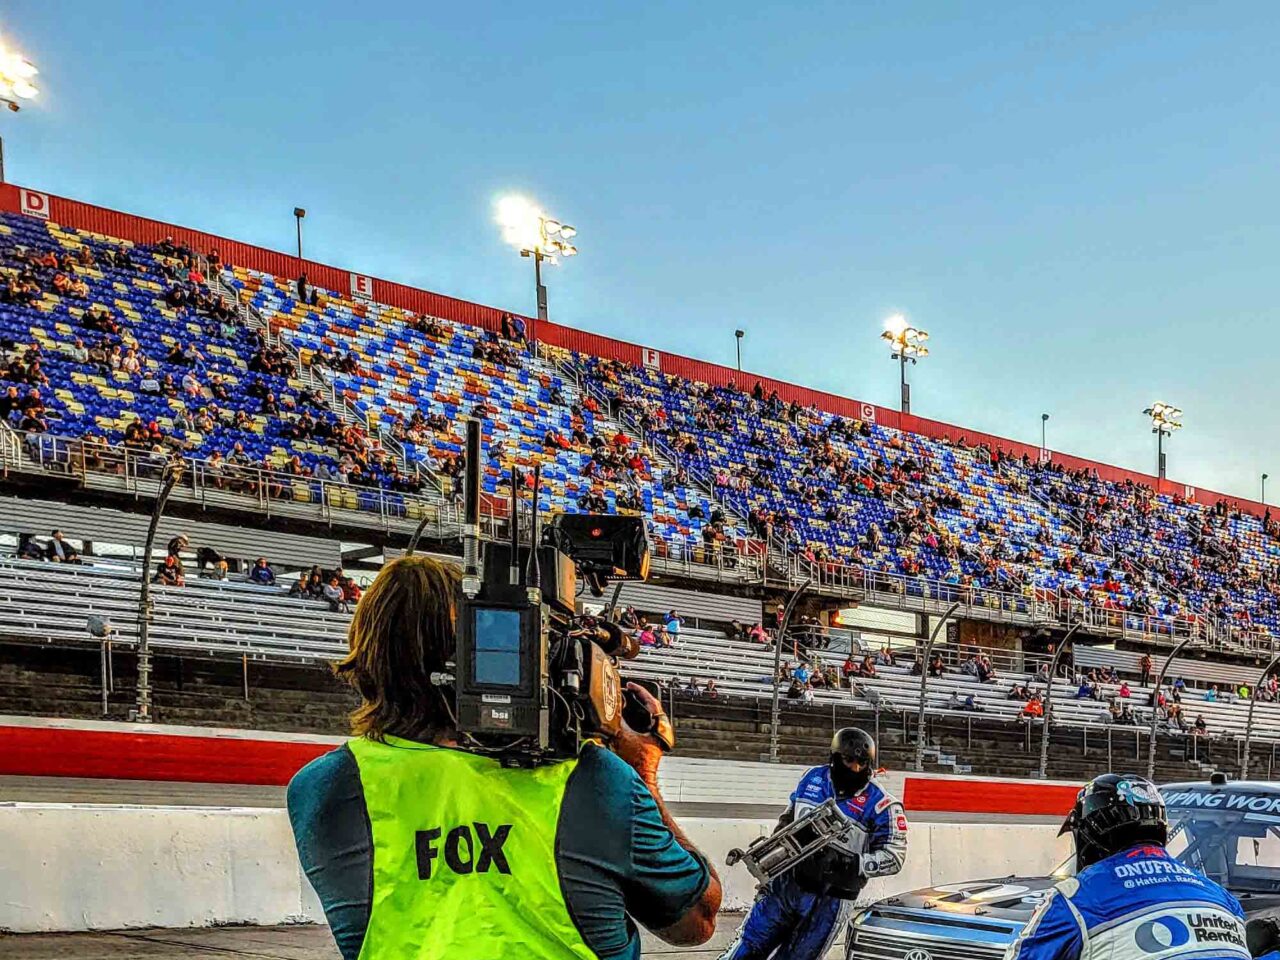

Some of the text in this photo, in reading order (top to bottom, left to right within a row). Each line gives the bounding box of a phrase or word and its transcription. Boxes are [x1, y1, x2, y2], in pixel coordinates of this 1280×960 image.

[25, 191, 44, 210] D
[356, 275, 366, 292] E
[647, 349, 656, 363] F
[863, 405, 873, 417] G
[1163, 792, 1227, 808] MPING
[415, 822, 514, 880] FOX
[1187, 913, 1239, 933] United
